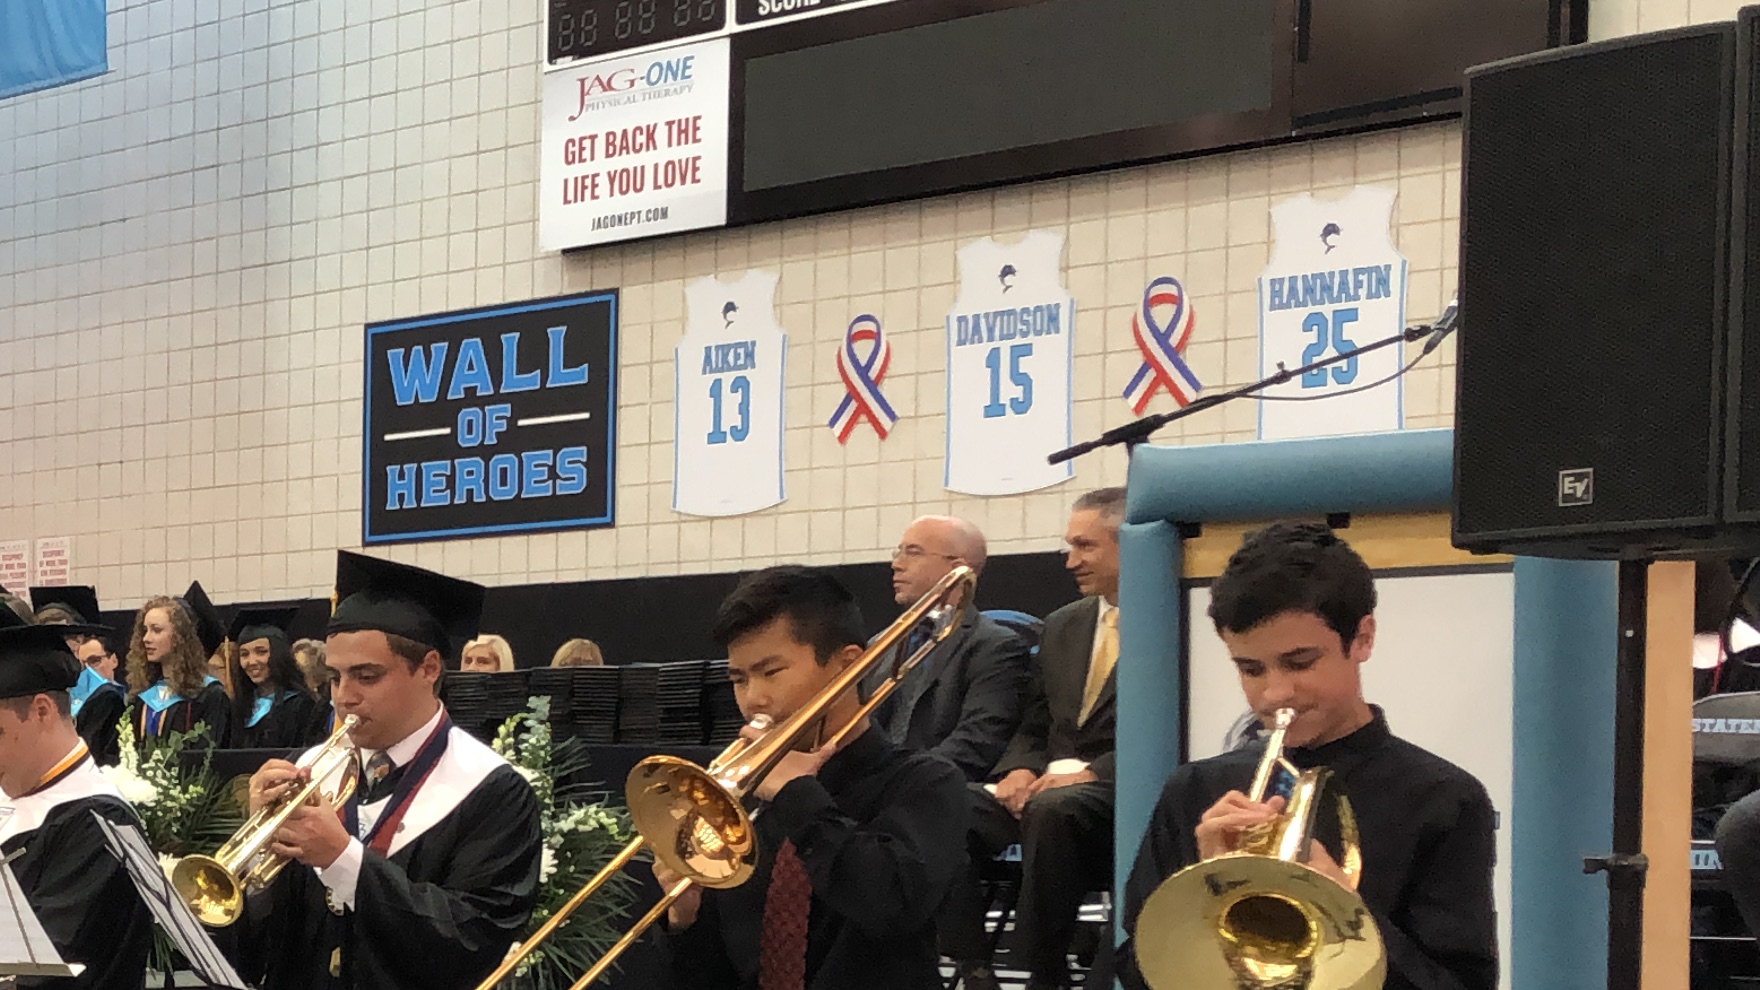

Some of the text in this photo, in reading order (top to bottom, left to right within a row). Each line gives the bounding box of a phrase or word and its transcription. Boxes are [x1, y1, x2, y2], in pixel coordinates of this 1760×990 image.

[568, 55, 695, 122] JAG-ONE
[584, 84, 694, 113] PHYSICAL THERAPY
[564, 115, 702, 166] GET BACK THE
[562, 155, 702, 206] LIFE YOU LOVE
[591, 206, 669, 231] JAGONEPT.COM
[1269, 263, 1392, 312] HANNAFIN
[956, 303, 1061, 347] DAVIDSON
[1302, 307, 1359, 389] 25
[387, 325, 589, 406] WALL
[702, 340, 756, 375] AIKEN
[983, 343, 1034, 418] 15
[457, 403, 511, 448] OF
[706, 375, 751, 445] 13
[386, 446, 588, 511] HEROES
